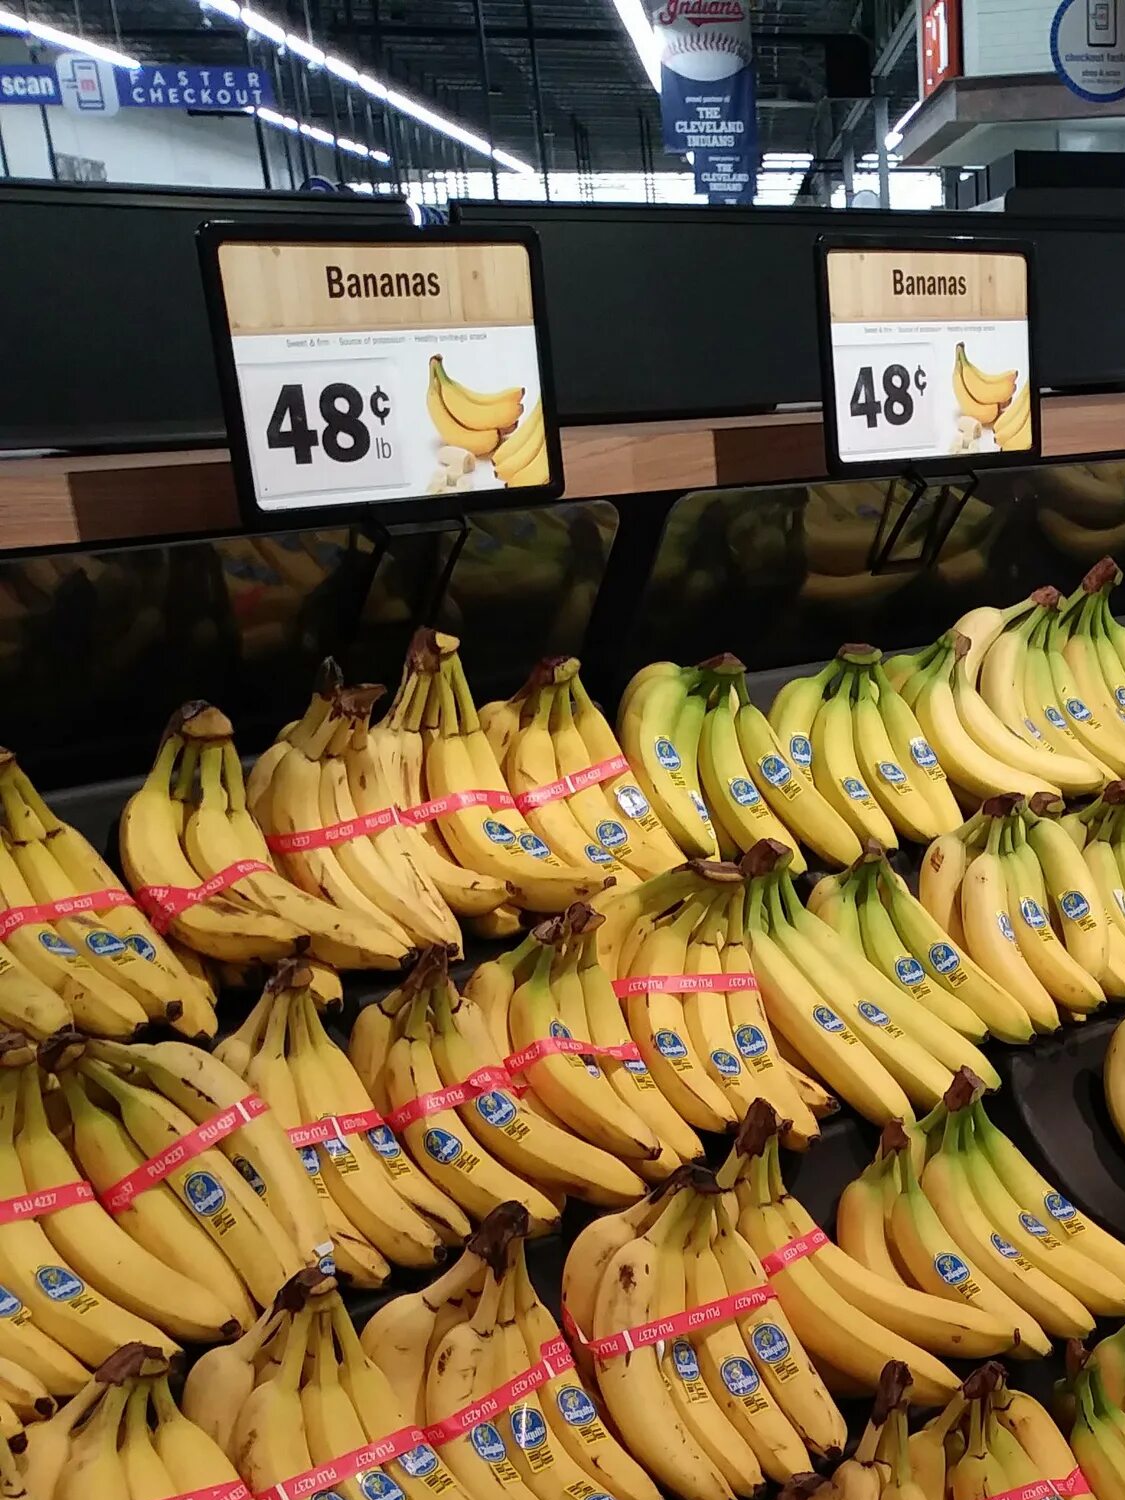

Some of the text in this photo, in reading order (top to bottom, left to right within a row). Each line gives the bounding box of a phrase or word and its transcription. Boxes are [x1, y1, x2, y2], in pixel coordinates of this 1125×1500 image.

[659, 0, 744, 25] Indians
[1, 75, 54, 96] scan
[130, 72, 260, 87] FASTER
[133, 88, 262, 104] CHECKOUT
[696, 107, 720, 118] THE
[675, 121, 744, 133] CLEVELAND
[687, 135, 734, 147] INDIANS
[326, 266, 441, 299] Bananas
[892, 269, 967, 296] Bananas
[376, 438, 392, 459] lb
[414, 801, 448, 819] PLU 4237
[443, 1089, 465, 1107] PLU
[199, 1113, 237, 1141] PLU 4237
[147, 1147, 185, 1177] PLU 4237
[14, 1193, 57, 1212] PLU 4237
[734, 1292, 766, 1311] PLU 4237
[689, 1306, 721, 1326] PLU 4237
[639, 1322, 673, 1342] PLU 4237
[600, 1342, 618, 1353] PLU
[759, 1340, 789, 1360] Chiquita
[511, 1369, 543, 1397] PLU 4237
[462, 1399, 497, 1426] PLU 4237
[565, 1405, 595, 1421] Chiquita
[356, 1442, 395, 1467] PLU 4237
[293, 1468, 337, 1495] PLU 4237
